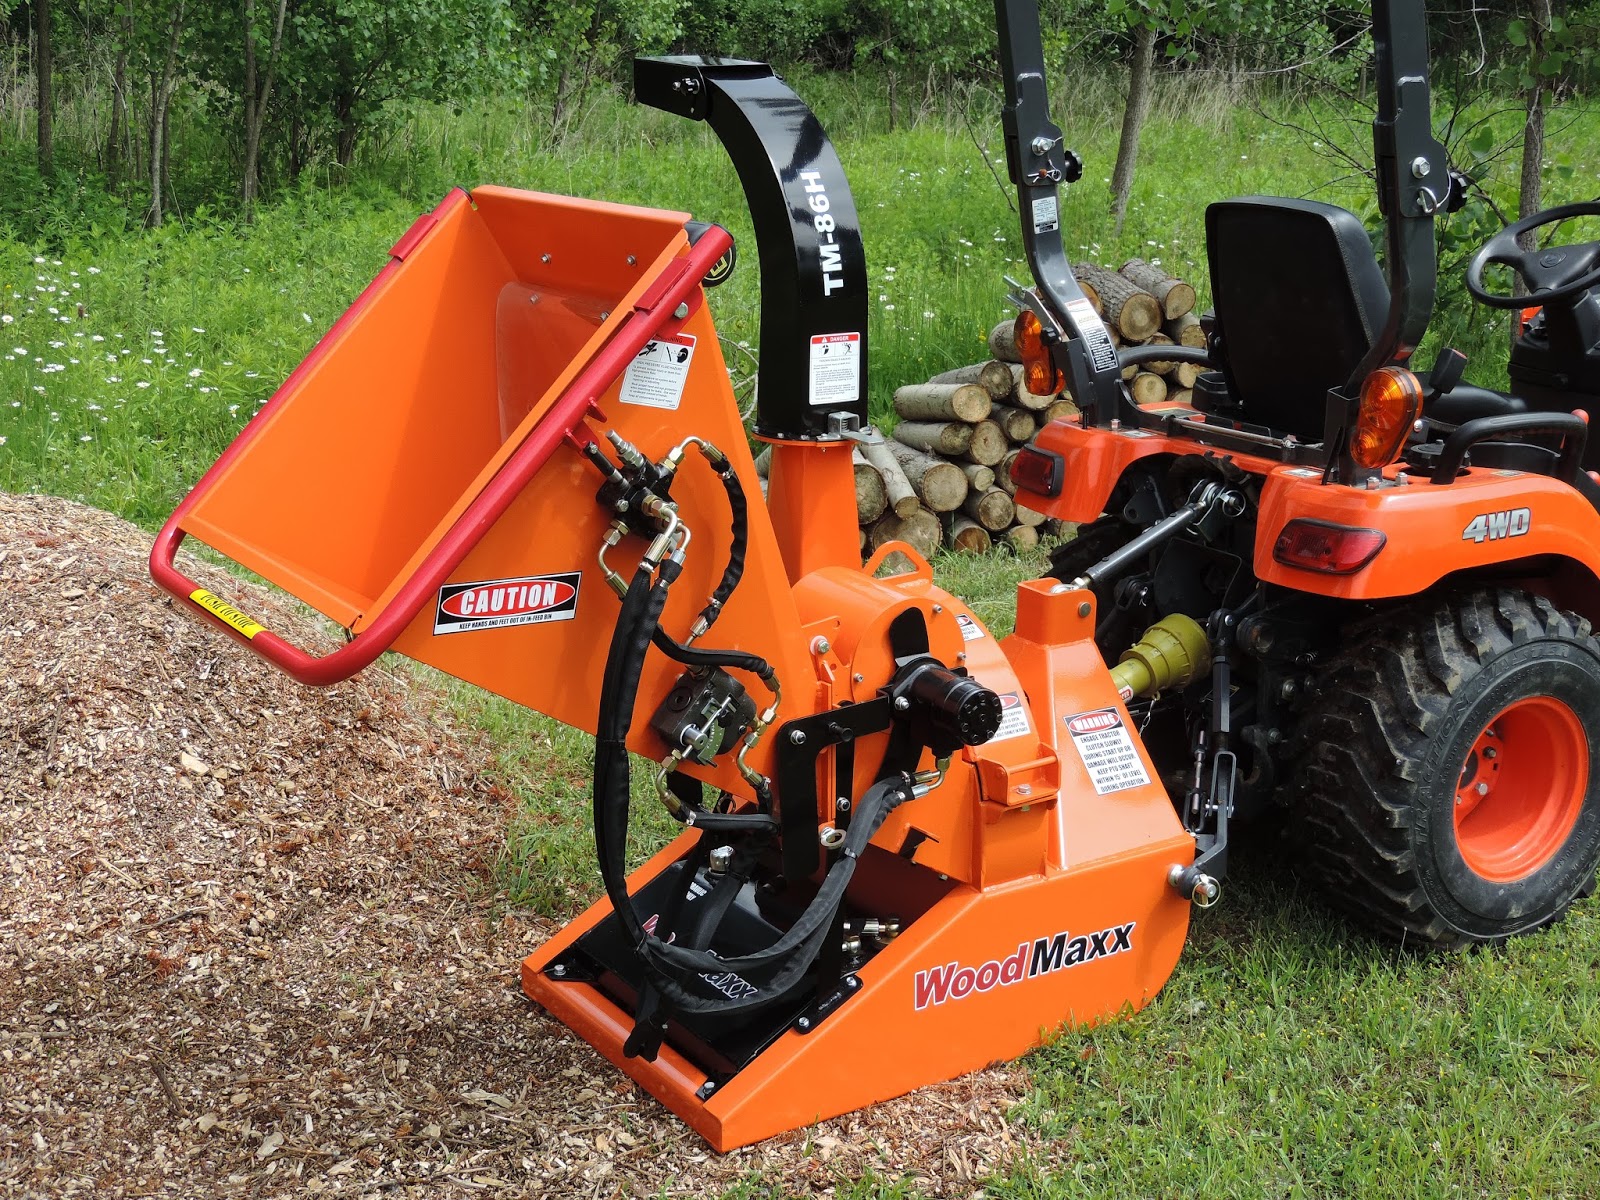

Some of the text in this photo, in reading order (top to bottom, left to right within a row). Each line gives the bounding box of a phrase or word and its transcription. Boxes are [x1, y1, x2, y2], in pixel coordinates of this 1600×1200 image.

[799, 171, 844, 297] TM-86H
[1462, 507, 1531, 544] 4WD
[460, 583, 557, 615] CAUTION
[472, 620, 488, 628] HANDS
[488, 619, 498, 627] AND
[499, 618, 509, 626] FEET
[509, 617, 519, 625] OUT
[519, 616, 526, 624] OF
[526, 615, 543, 623] IN-FEED
[1072, 713, 1115, 731] WARNING
[1081, 730, 1120, 743] ENGAGE TRACTOR
[1086, 739, 1122, 751] CLUTCH SLOWLY
[1084, 751, 1102, 760] DURING
[1103, 748, 1117, 757] START
[1087, 759, 1107, 768] DAMAGE
[1107, 756, 1119, 764] WILL
[1097, 767, 1109, 775] KEEP
[1119, 762, 1133, 770] SHAFT
[1096, 775, 1114, 784] WITHIN
[1129, 769, 1142, 777] LEVEL
[1100, 778, 1145, 792] DURING OPERATION
[914, 921, 1136, 1011] WoodMaxx
